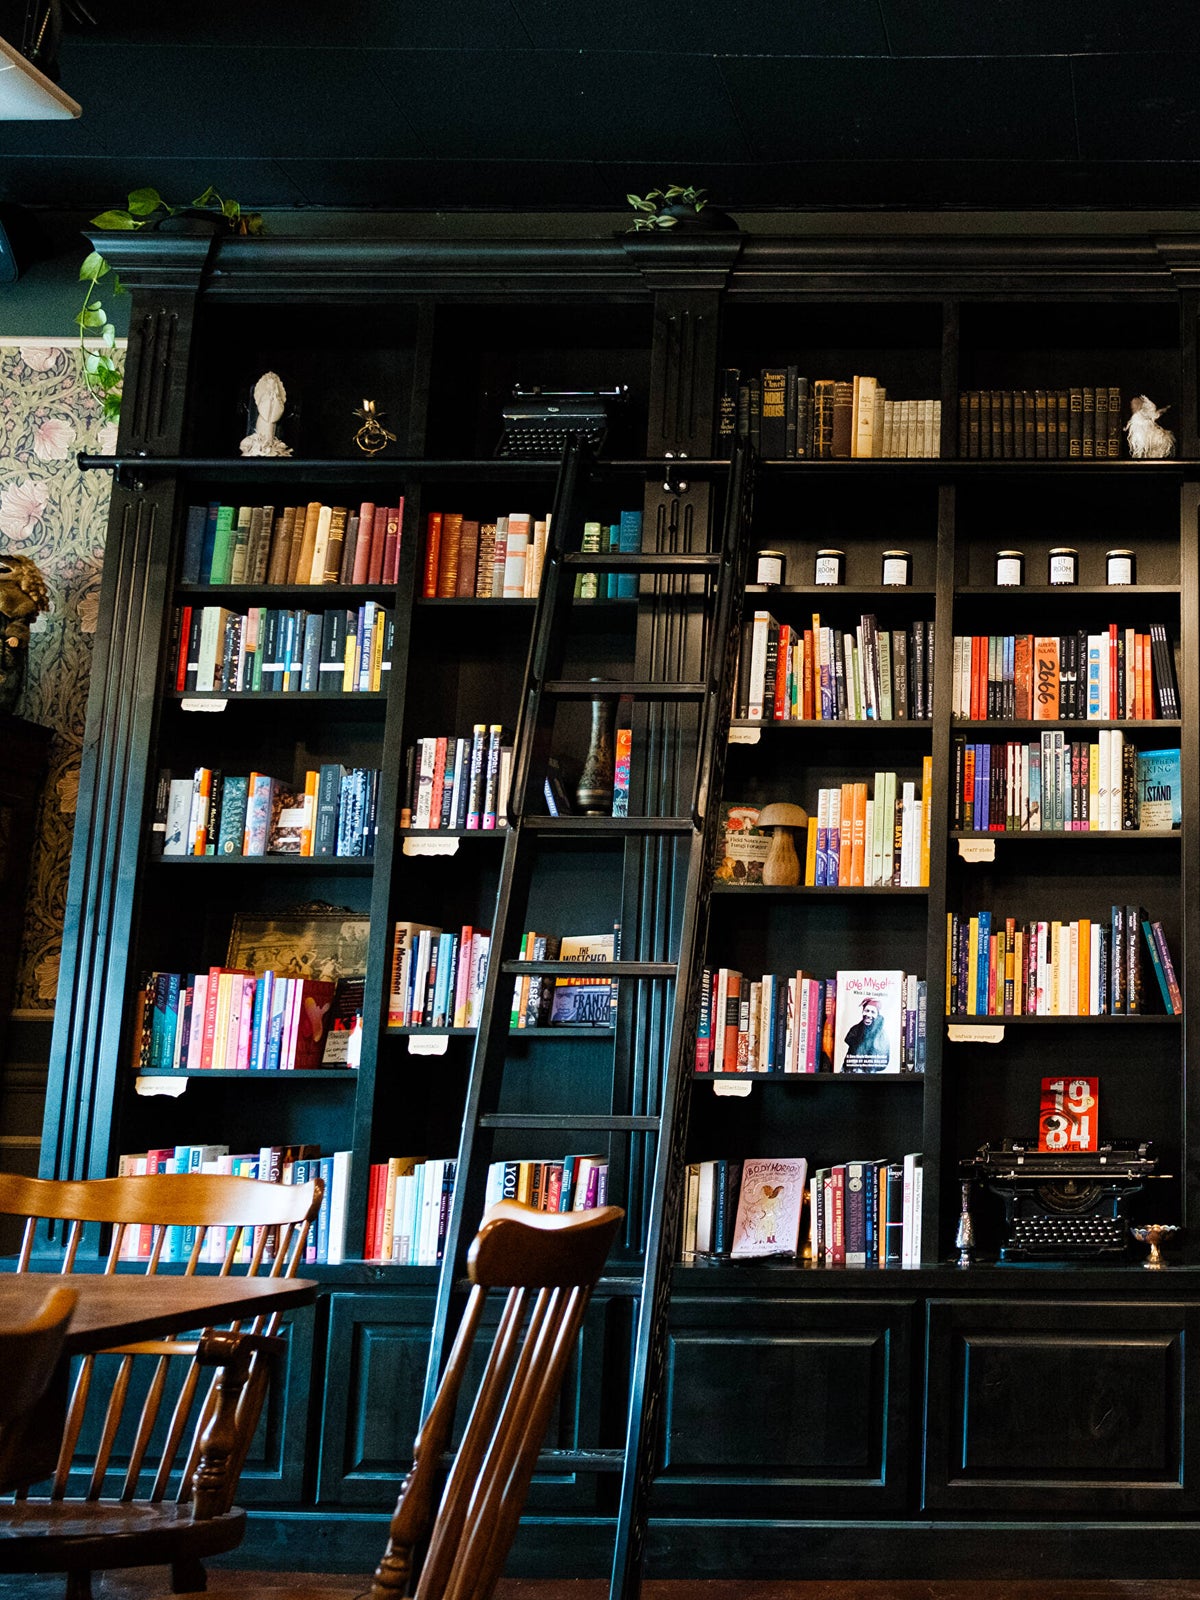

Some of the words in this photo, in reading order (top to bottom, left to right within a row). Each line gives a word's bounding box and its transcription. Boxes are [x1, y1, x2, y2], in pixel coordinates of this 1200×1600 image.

[764, 392, 785, 404] NOBLE
[764, 404, 785, 417] HOUSE
[881, 644, 889, 694] BEAVERLAND
[1038, 660, 1055, 704] 2666
[1147, 785, 1171, 801] STAND
[842, 820, 850, 845] BITE
[398, 929, 407, 944] The
[394, 948, 406, 995] Movement
[185, 987, 194, 1006] Kink
[210, 992, 216, 1004] AS
[701, 970, 710, 1007] FOURTEEN
[1050, 1081, 1091, 1113] 19
[1045, 1115, 1089, 1149] 84
[271, 1152, 280, 1166] Ina
[504, 1166, 516, 1198] YOU
[550, 1196, 556, 1205] OF
